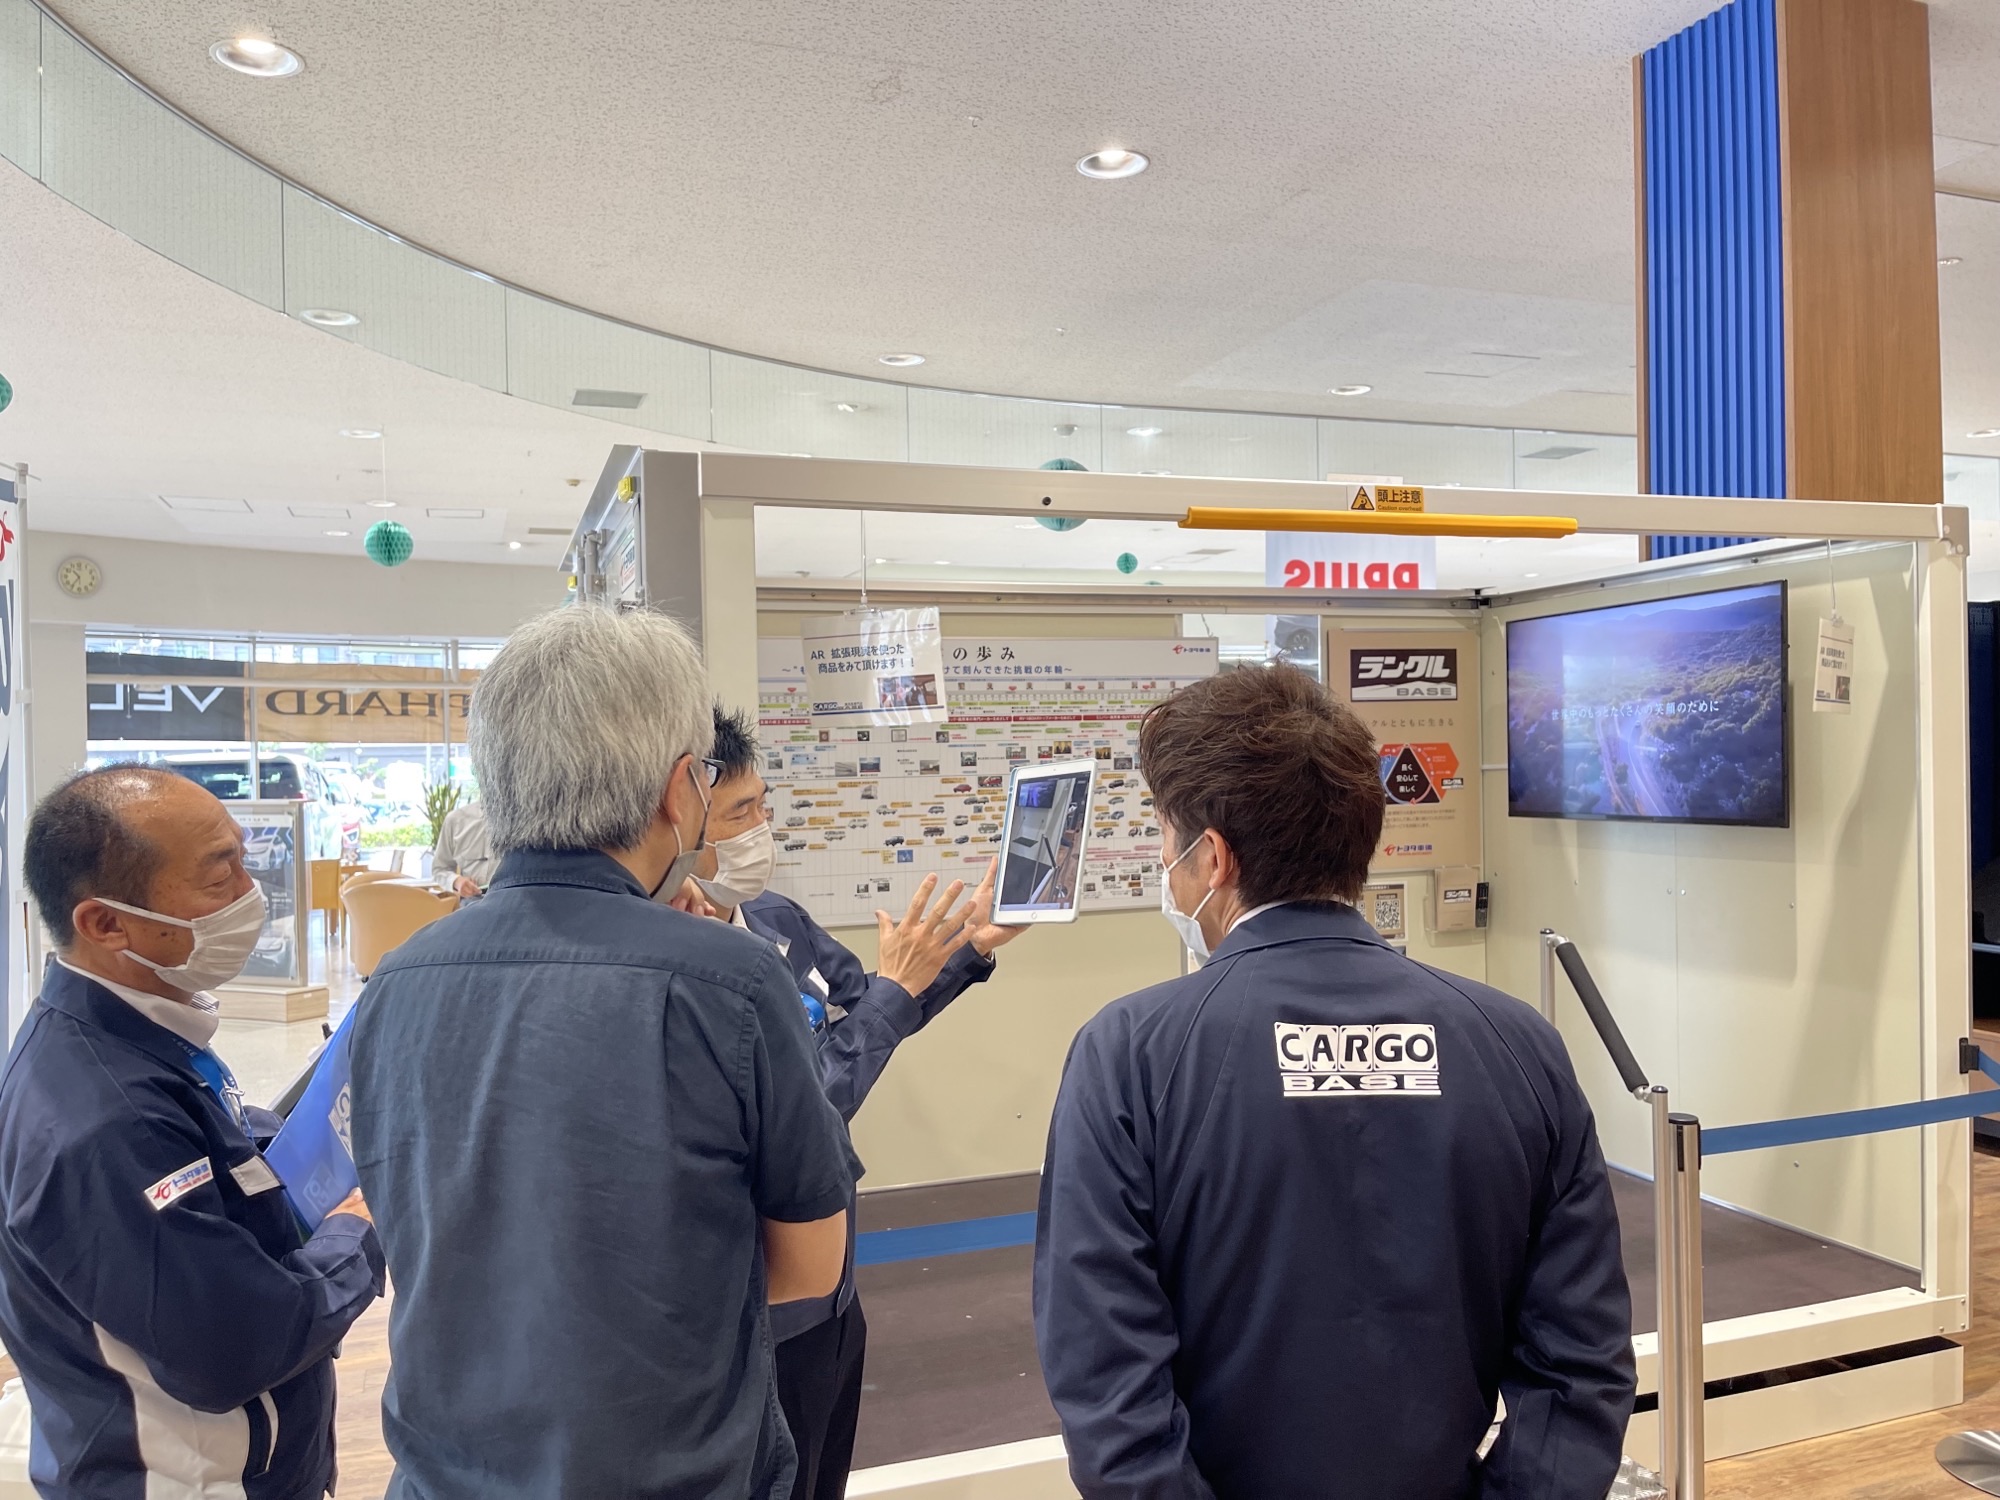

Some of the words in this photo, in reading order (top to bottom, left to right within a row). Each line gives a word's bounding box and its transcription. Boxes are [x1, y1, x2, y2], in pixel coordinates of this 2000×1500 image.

[1377, 489, 1422, 504] 頭上注意
[810, 650, 826, 660] AR
[831, 643, 905, 659] 拡張現実を使った
[1357, 655, 1451, 679] ランクル
[1396, 687, 1452, 696] BASE
[1551, 700, 1720, 721] 世界中のもっとたくさんの笑顔のために
[1401, 763, 1413, 771] 長く
[1396, 774, 1419, 783] 安心して
[1279, 1031, 1436, 1064] CARGO
[1282, 1073, 1441, 1091] BASE
